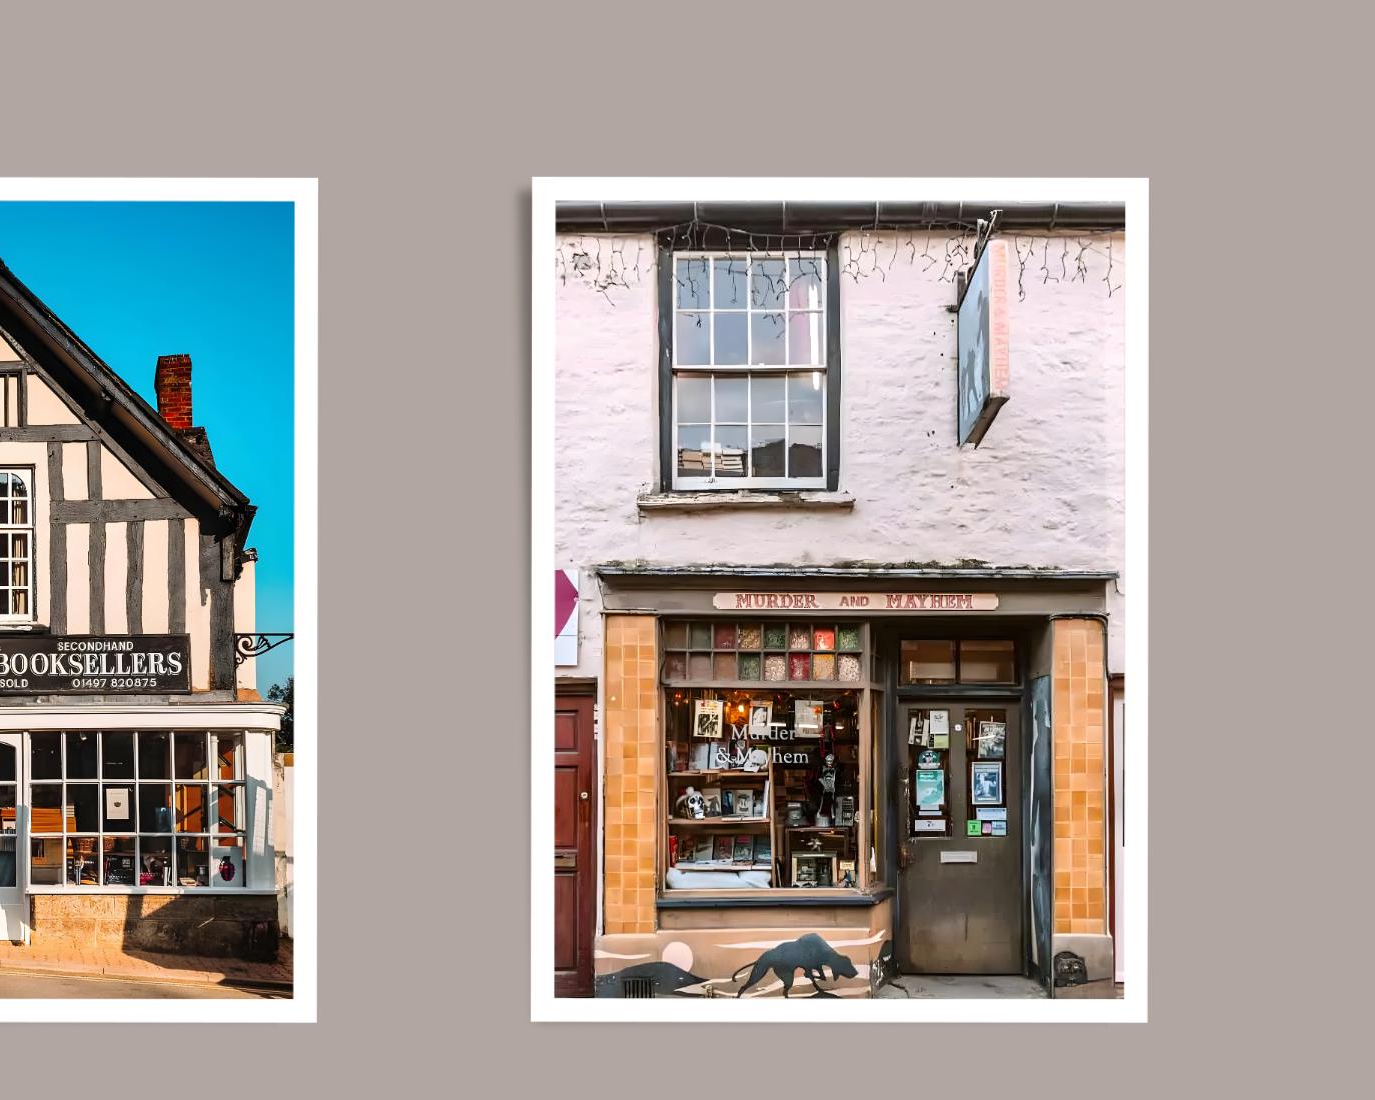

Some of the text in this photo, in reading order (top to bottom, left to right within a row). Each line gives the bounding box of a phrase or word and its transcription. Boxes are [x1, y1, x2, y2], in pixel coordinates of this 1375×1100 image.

[735, 593, 973, 609] MURDER AND MAYHEM
[57, 641, 134, 651] SECONDHAND
[72, 678, 107, 688] 01497
[110, 678, 157, 688] 820875
[736, 746, 809, 768] Mhem
